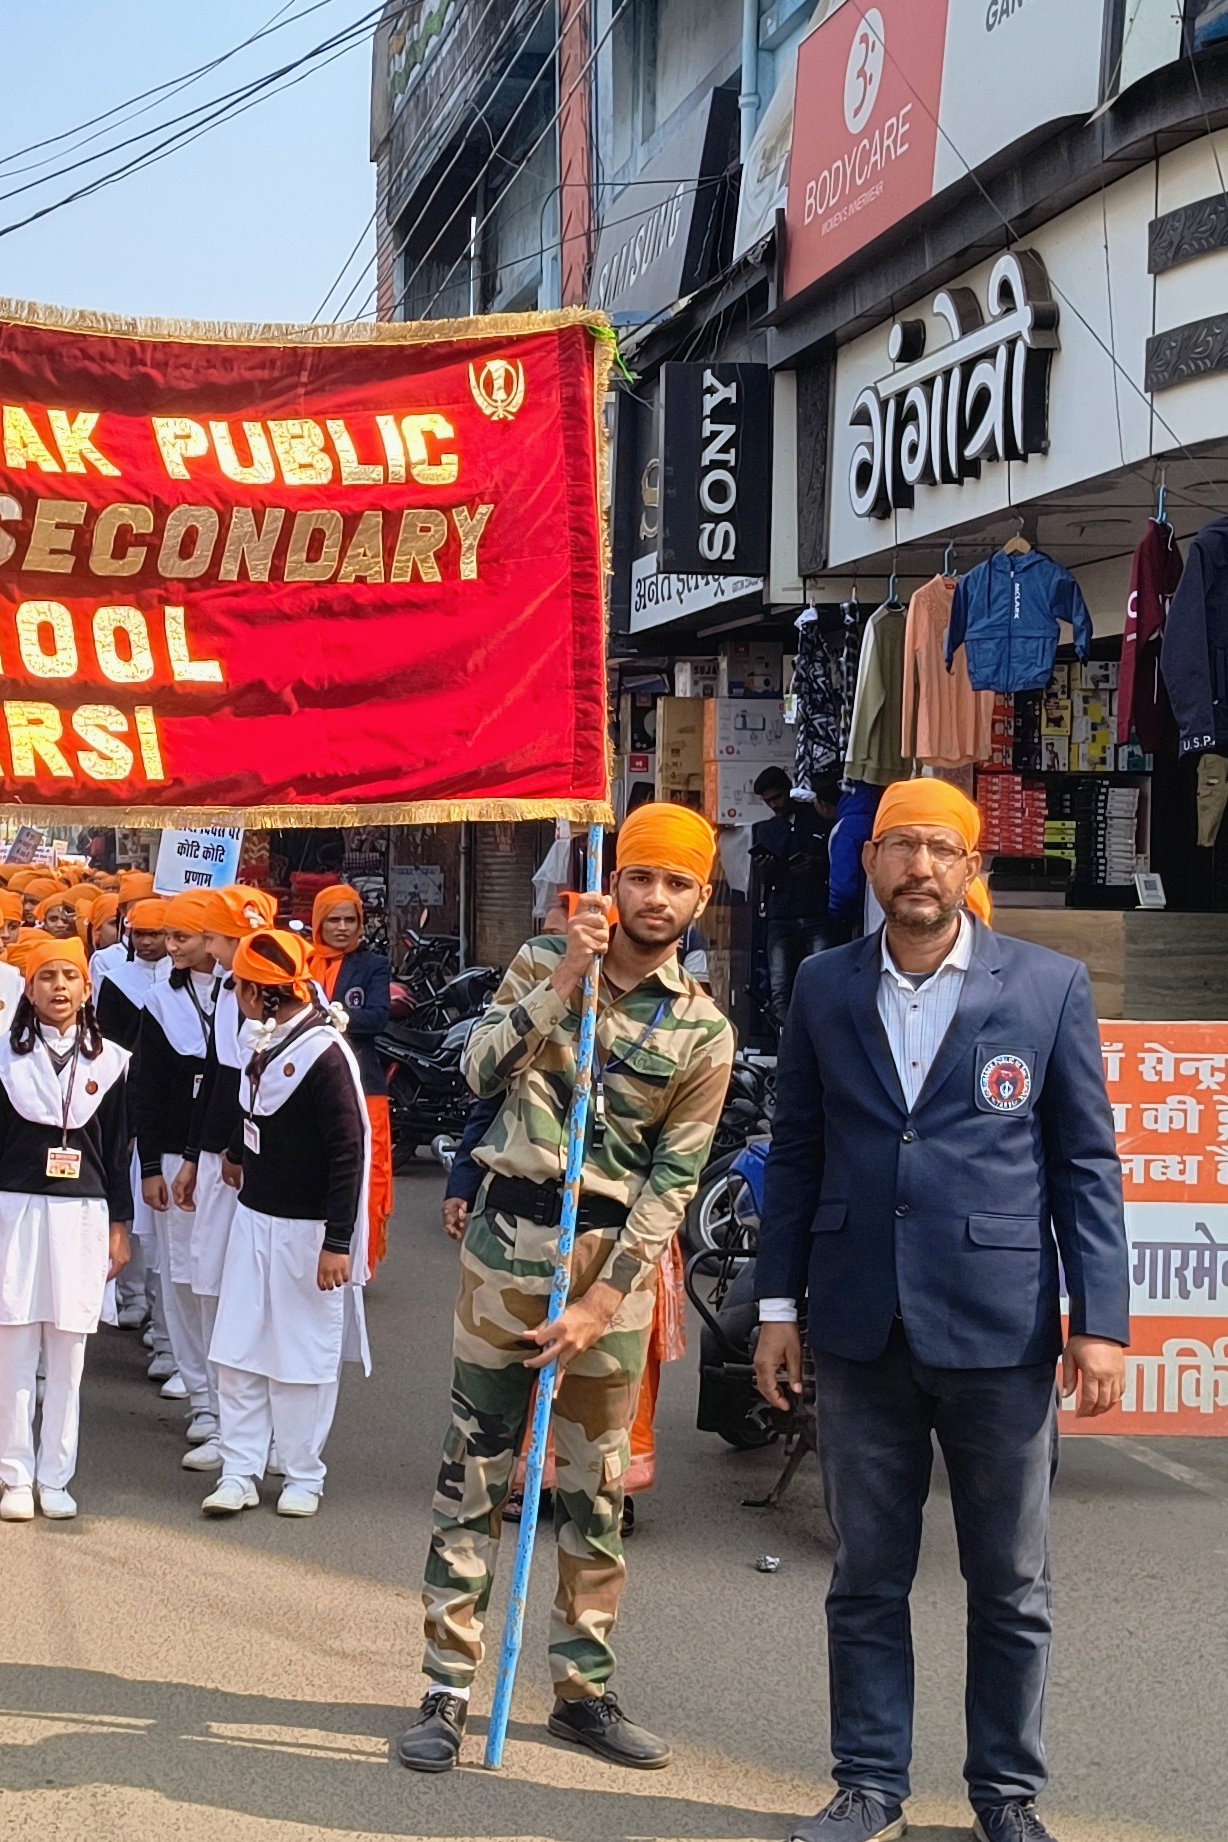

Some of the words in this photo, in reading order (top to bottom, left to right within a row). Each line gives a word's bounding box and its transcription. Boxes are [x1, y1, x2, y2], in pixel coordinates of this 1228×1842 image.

[803, 102, 913, 226] BODYCARE
[595, 182, 685, 311] SAMSUNG
[848, 250, 1036, 518] गंगोत्री
[151, 412, 459, 486] PUBLIC
[698, 368, 737, 561] SONY
[176, 839, 200, 859] कोटि
[202, 843, 226, 862] कोटि
[184, 870, 214, 887] प्रणाम
[1137, 1042, 1228, 1090] सेन्ट्र
[1140, 1095, 1204, 1134] की
[1119, 1154, 1203, 1184] लब्ध
[1132, 1222, 1228, 1301] गारमे
